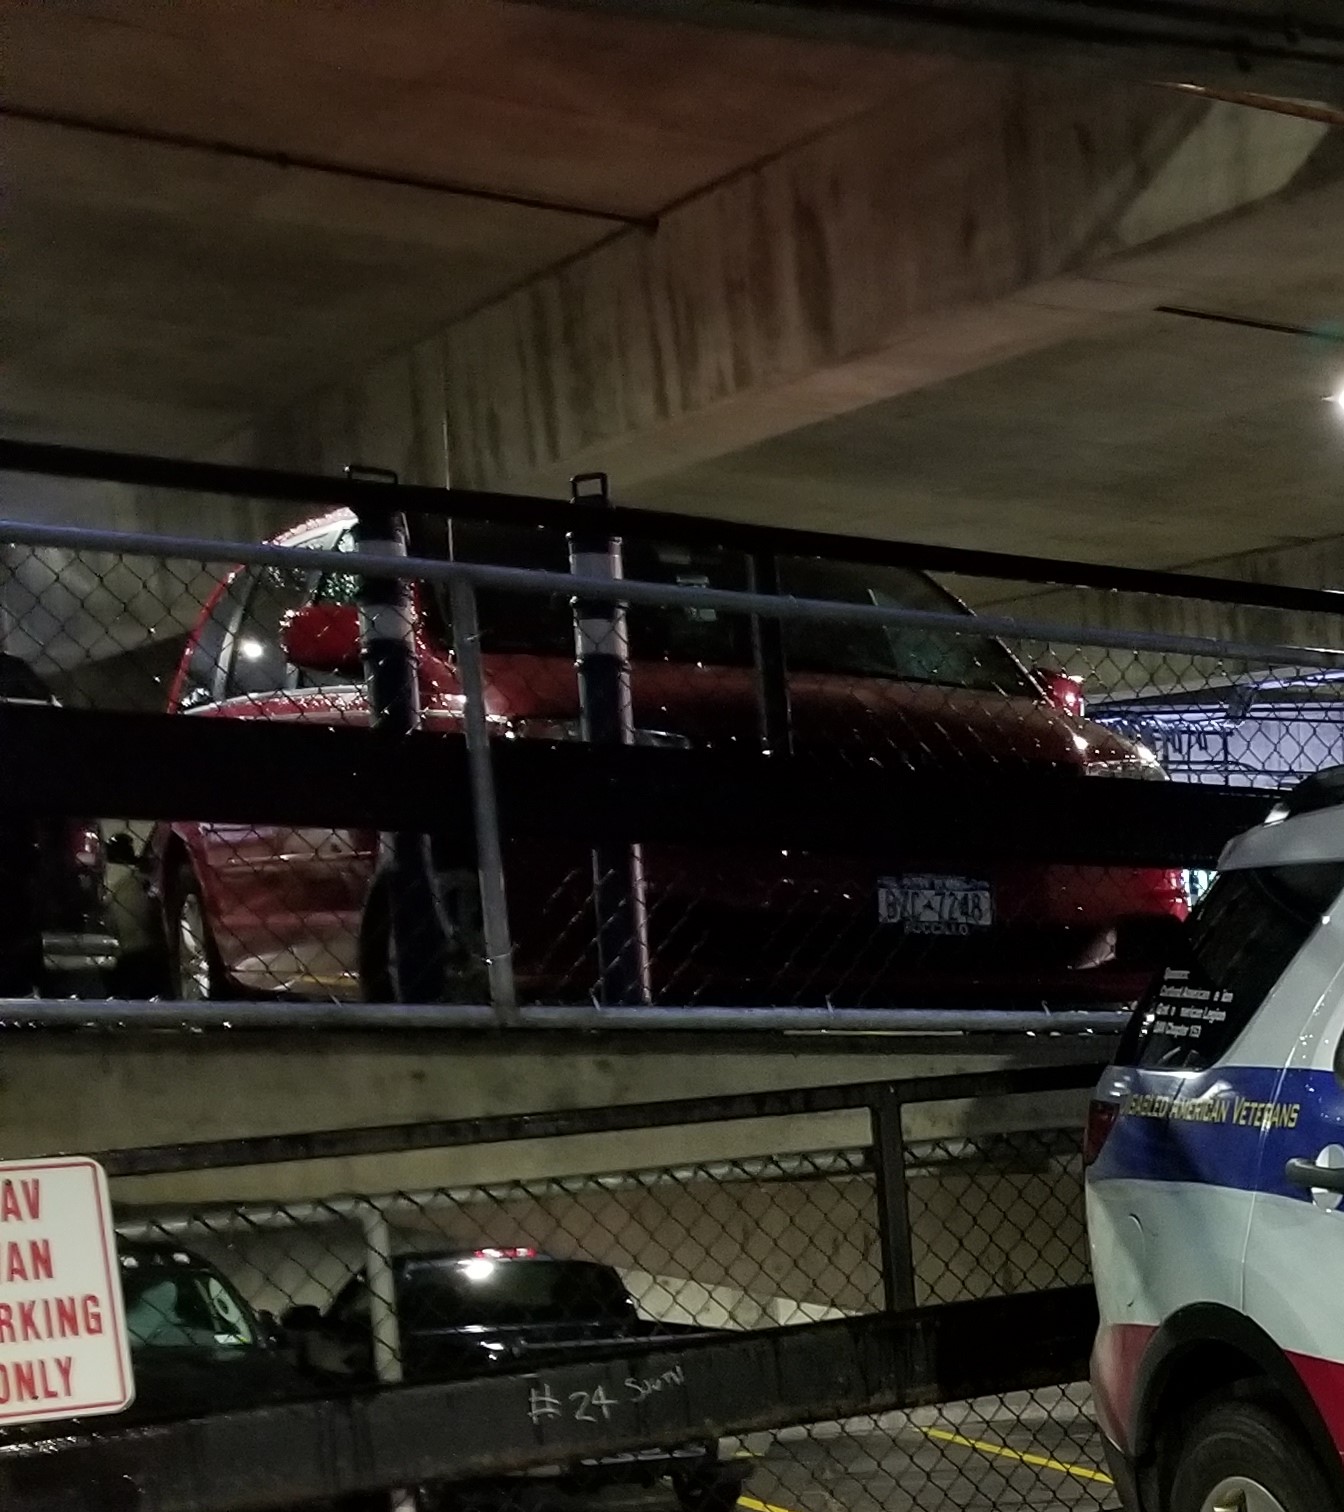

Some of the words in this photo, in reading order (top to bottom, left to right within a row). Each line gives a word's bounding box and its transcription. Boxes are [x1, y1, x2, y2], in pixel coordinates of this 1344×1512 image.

[1232, 1096, 1300, 1130] VETERANS
[0, 1177, 41, 1222] AV
[0, 1238, 54, 1281] AN
[0, 1294, 104, 1343] RKING
